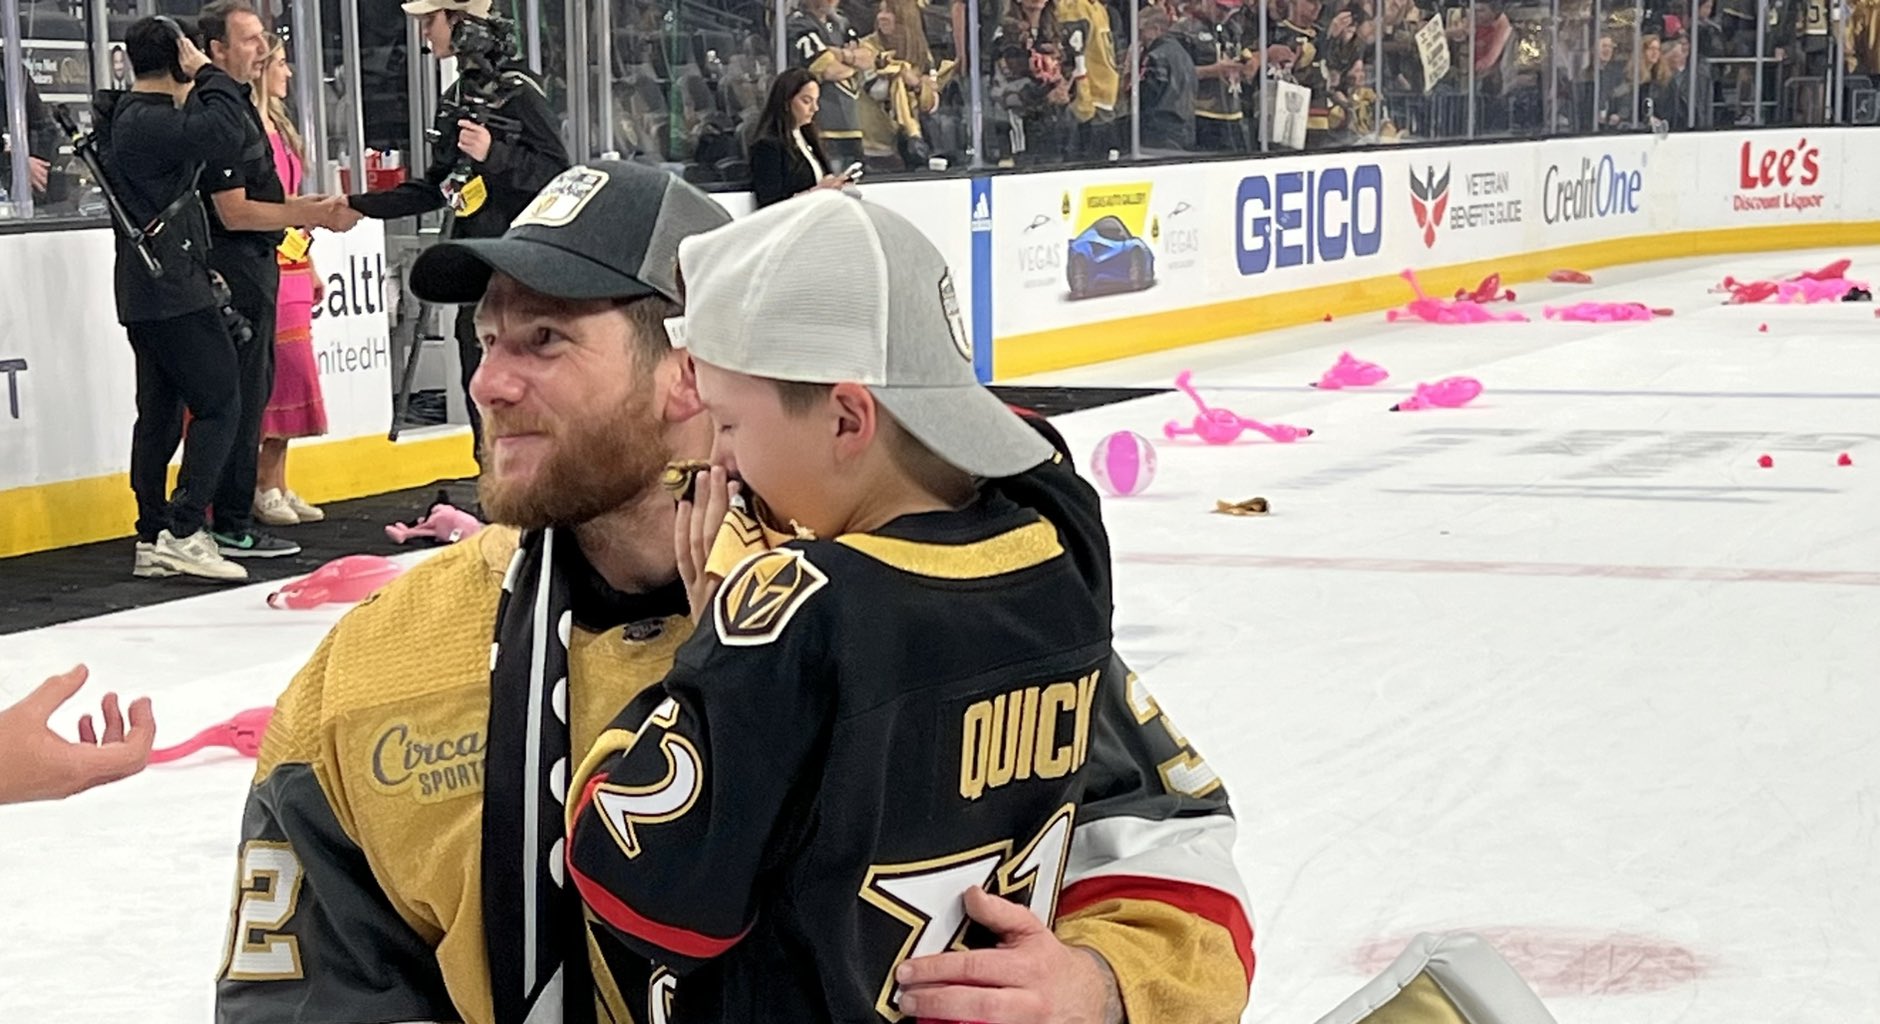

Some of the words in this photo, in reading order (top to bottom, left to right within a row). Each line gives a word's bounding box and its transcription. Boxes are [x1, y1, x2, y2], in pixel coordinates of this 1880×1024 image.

[1739, 137, 1819, 190] Lee's
[1465, 171, 1510, 197] VETERAN
[1450, 203, 1496, 230] BENEFITS
[1497, 200, 1522, 224] GUIDE
[1733, 194, 1780, 211] Discount
[1783, 192, 1824, 213] Liquor
[1235, 163, 1382, 276] GEICO
[1164, 229, 1199, 255] VEGAS
[1018, 243, 1061, 272] VEGAS
[372, 723, 488, 787] Circa
[418, 758, 486, 796] SPORT
